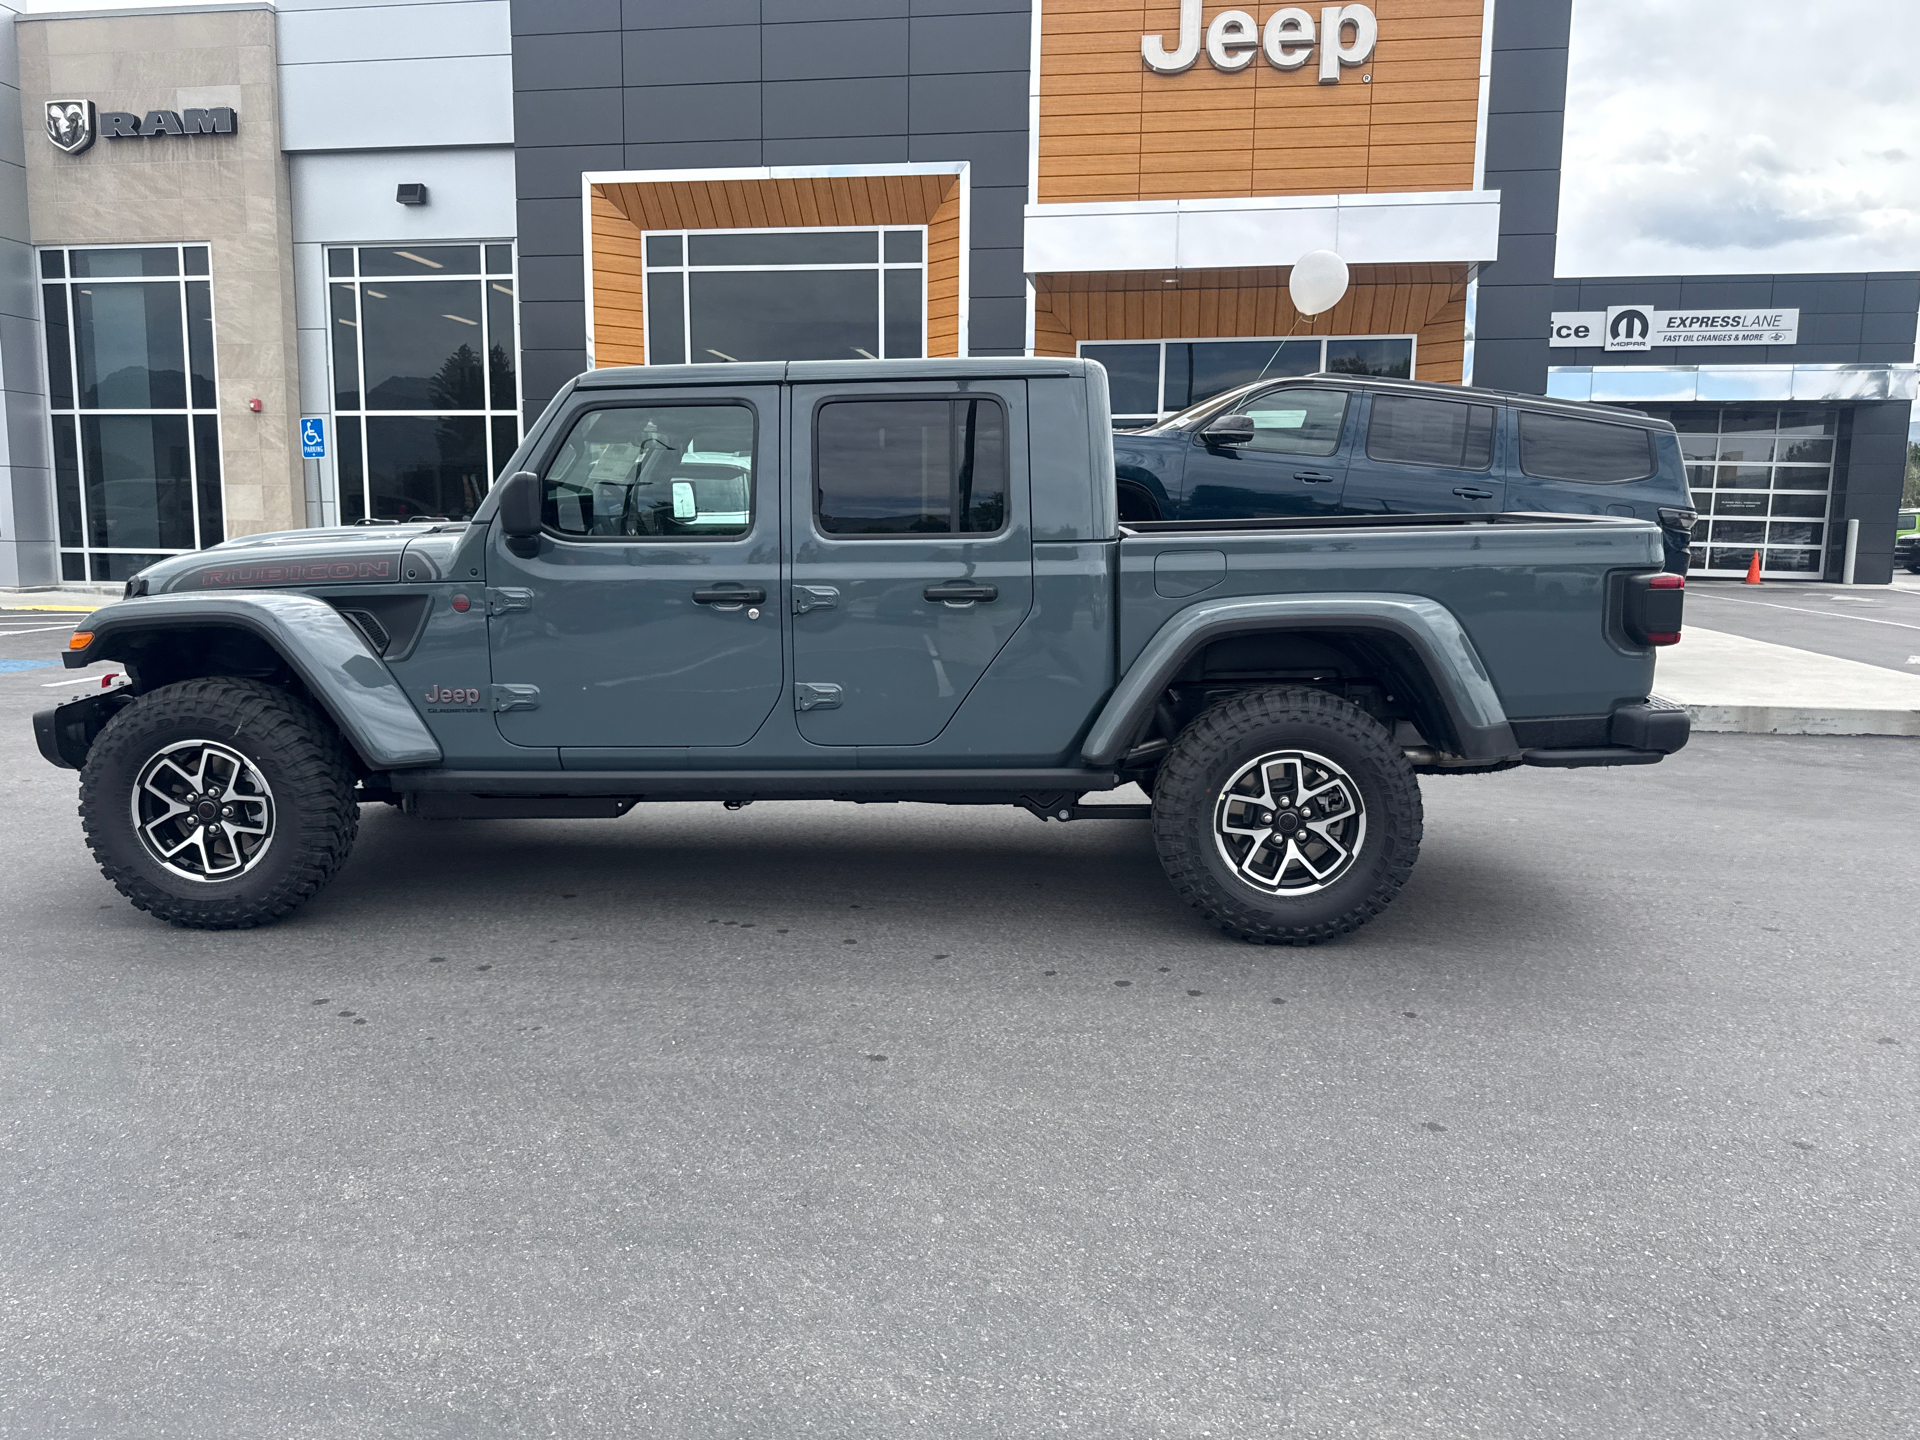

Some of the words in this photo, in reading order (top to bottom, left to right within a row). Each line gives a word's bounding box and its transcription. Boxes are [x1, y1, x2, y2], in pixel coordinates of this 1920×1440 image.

[1141, 0, 1378, 83] Jeep
[99, 107, 238, 138] RAM
[1662, 334, 1682, 343] FAST
[1683, 334, 1695, 342] OIL
[1696, 333, 1732, 342] CHANGES
[1733, 333, 1740, 341] &
[1741, 333, 1765, 341] MORE
[303, 445, 324, 453] PARKING
[202, 561, 390, 586] RUBICON
[424, 684, 481, 707] Jeep
